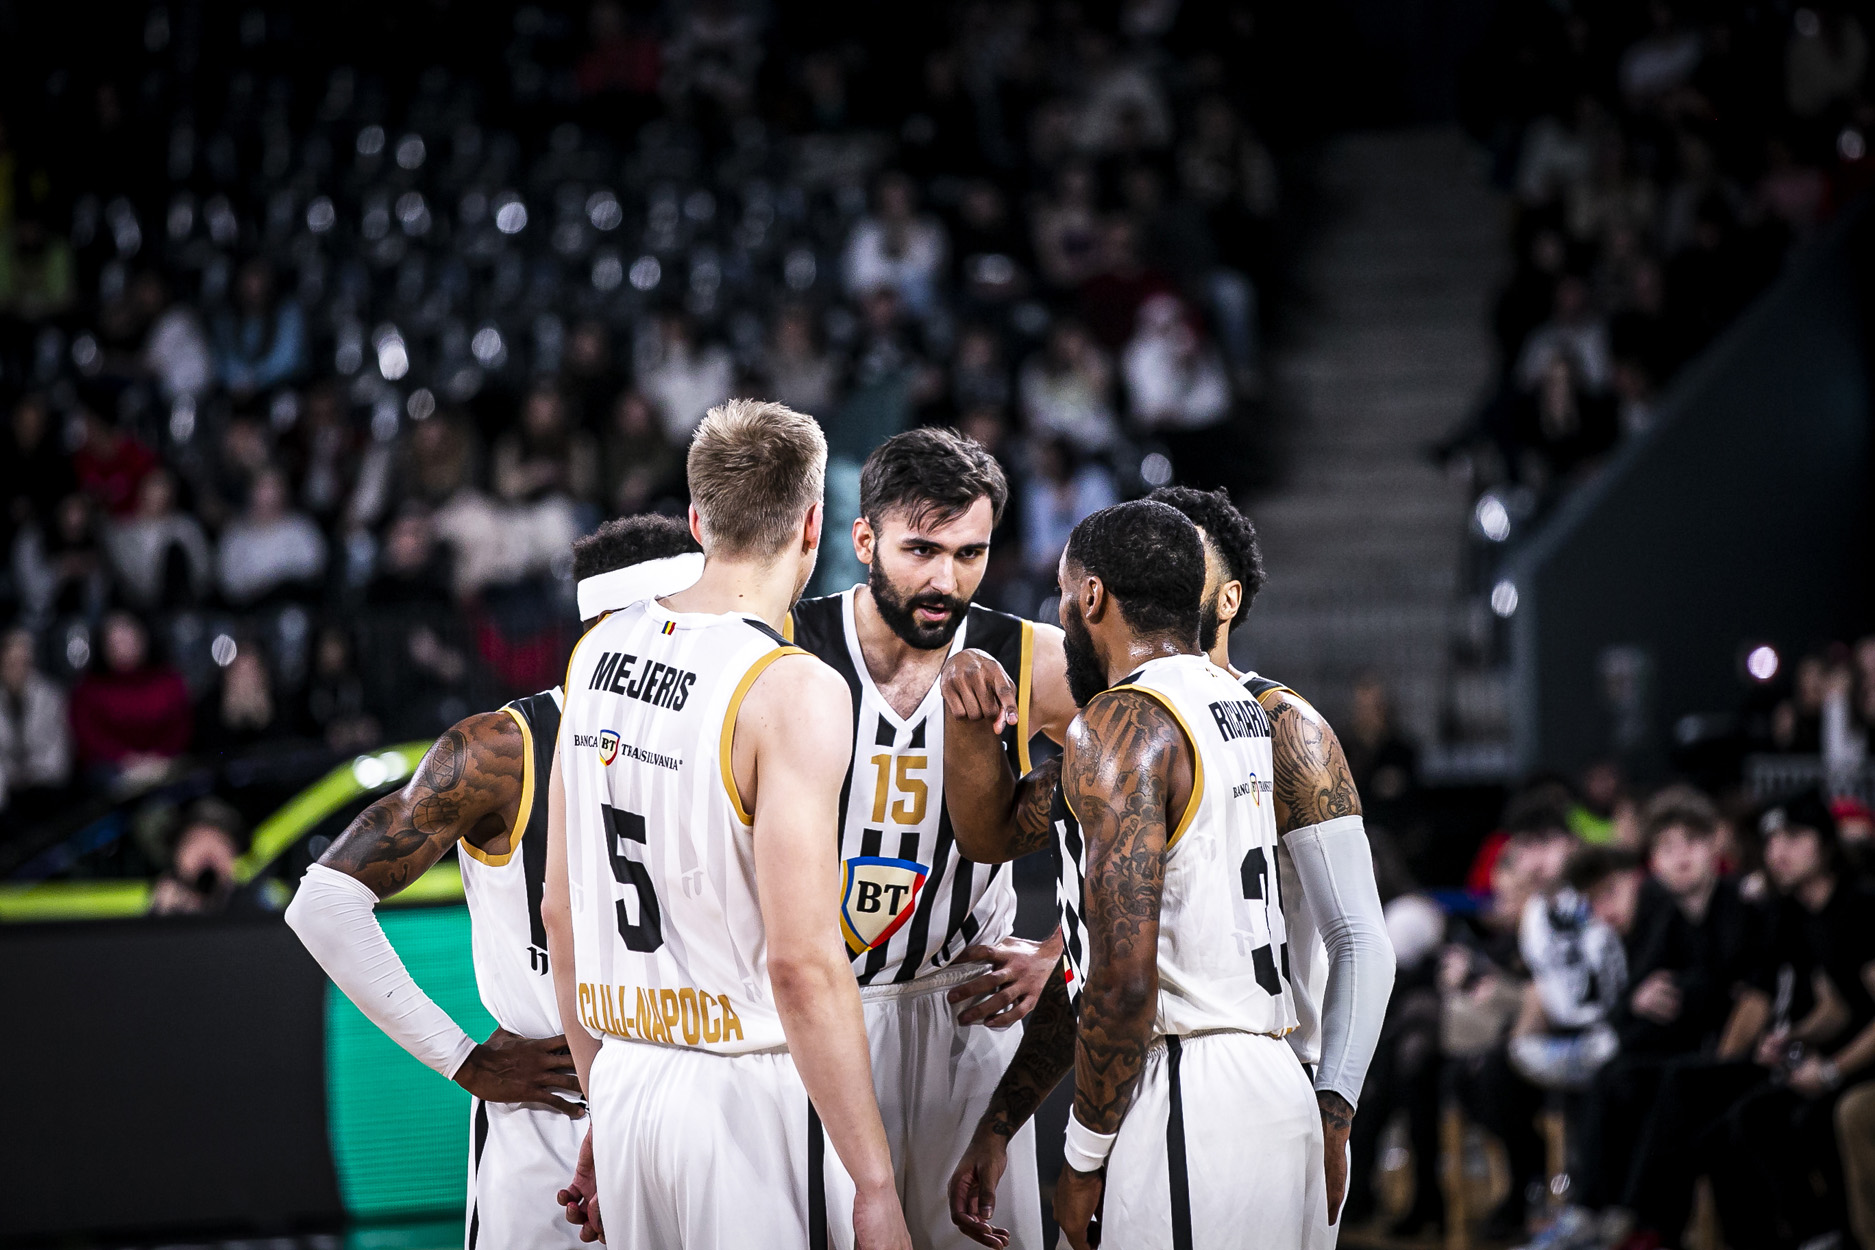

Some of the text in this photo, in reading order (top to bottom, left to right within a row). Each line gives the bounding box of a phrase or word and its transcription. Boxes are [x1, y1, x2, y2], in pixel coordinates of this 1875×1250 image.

[588, 652, 697, 712] MEJERIS
[574, 734, 679, 771] BANCA BT TRASILVANIA
[871, 753, 928, 825] 15
[601, 803, 664, 953] 5
[856, 880, 909, 915] BT
[578, 982, 744, 1046] CLUJ-NAPOCA
